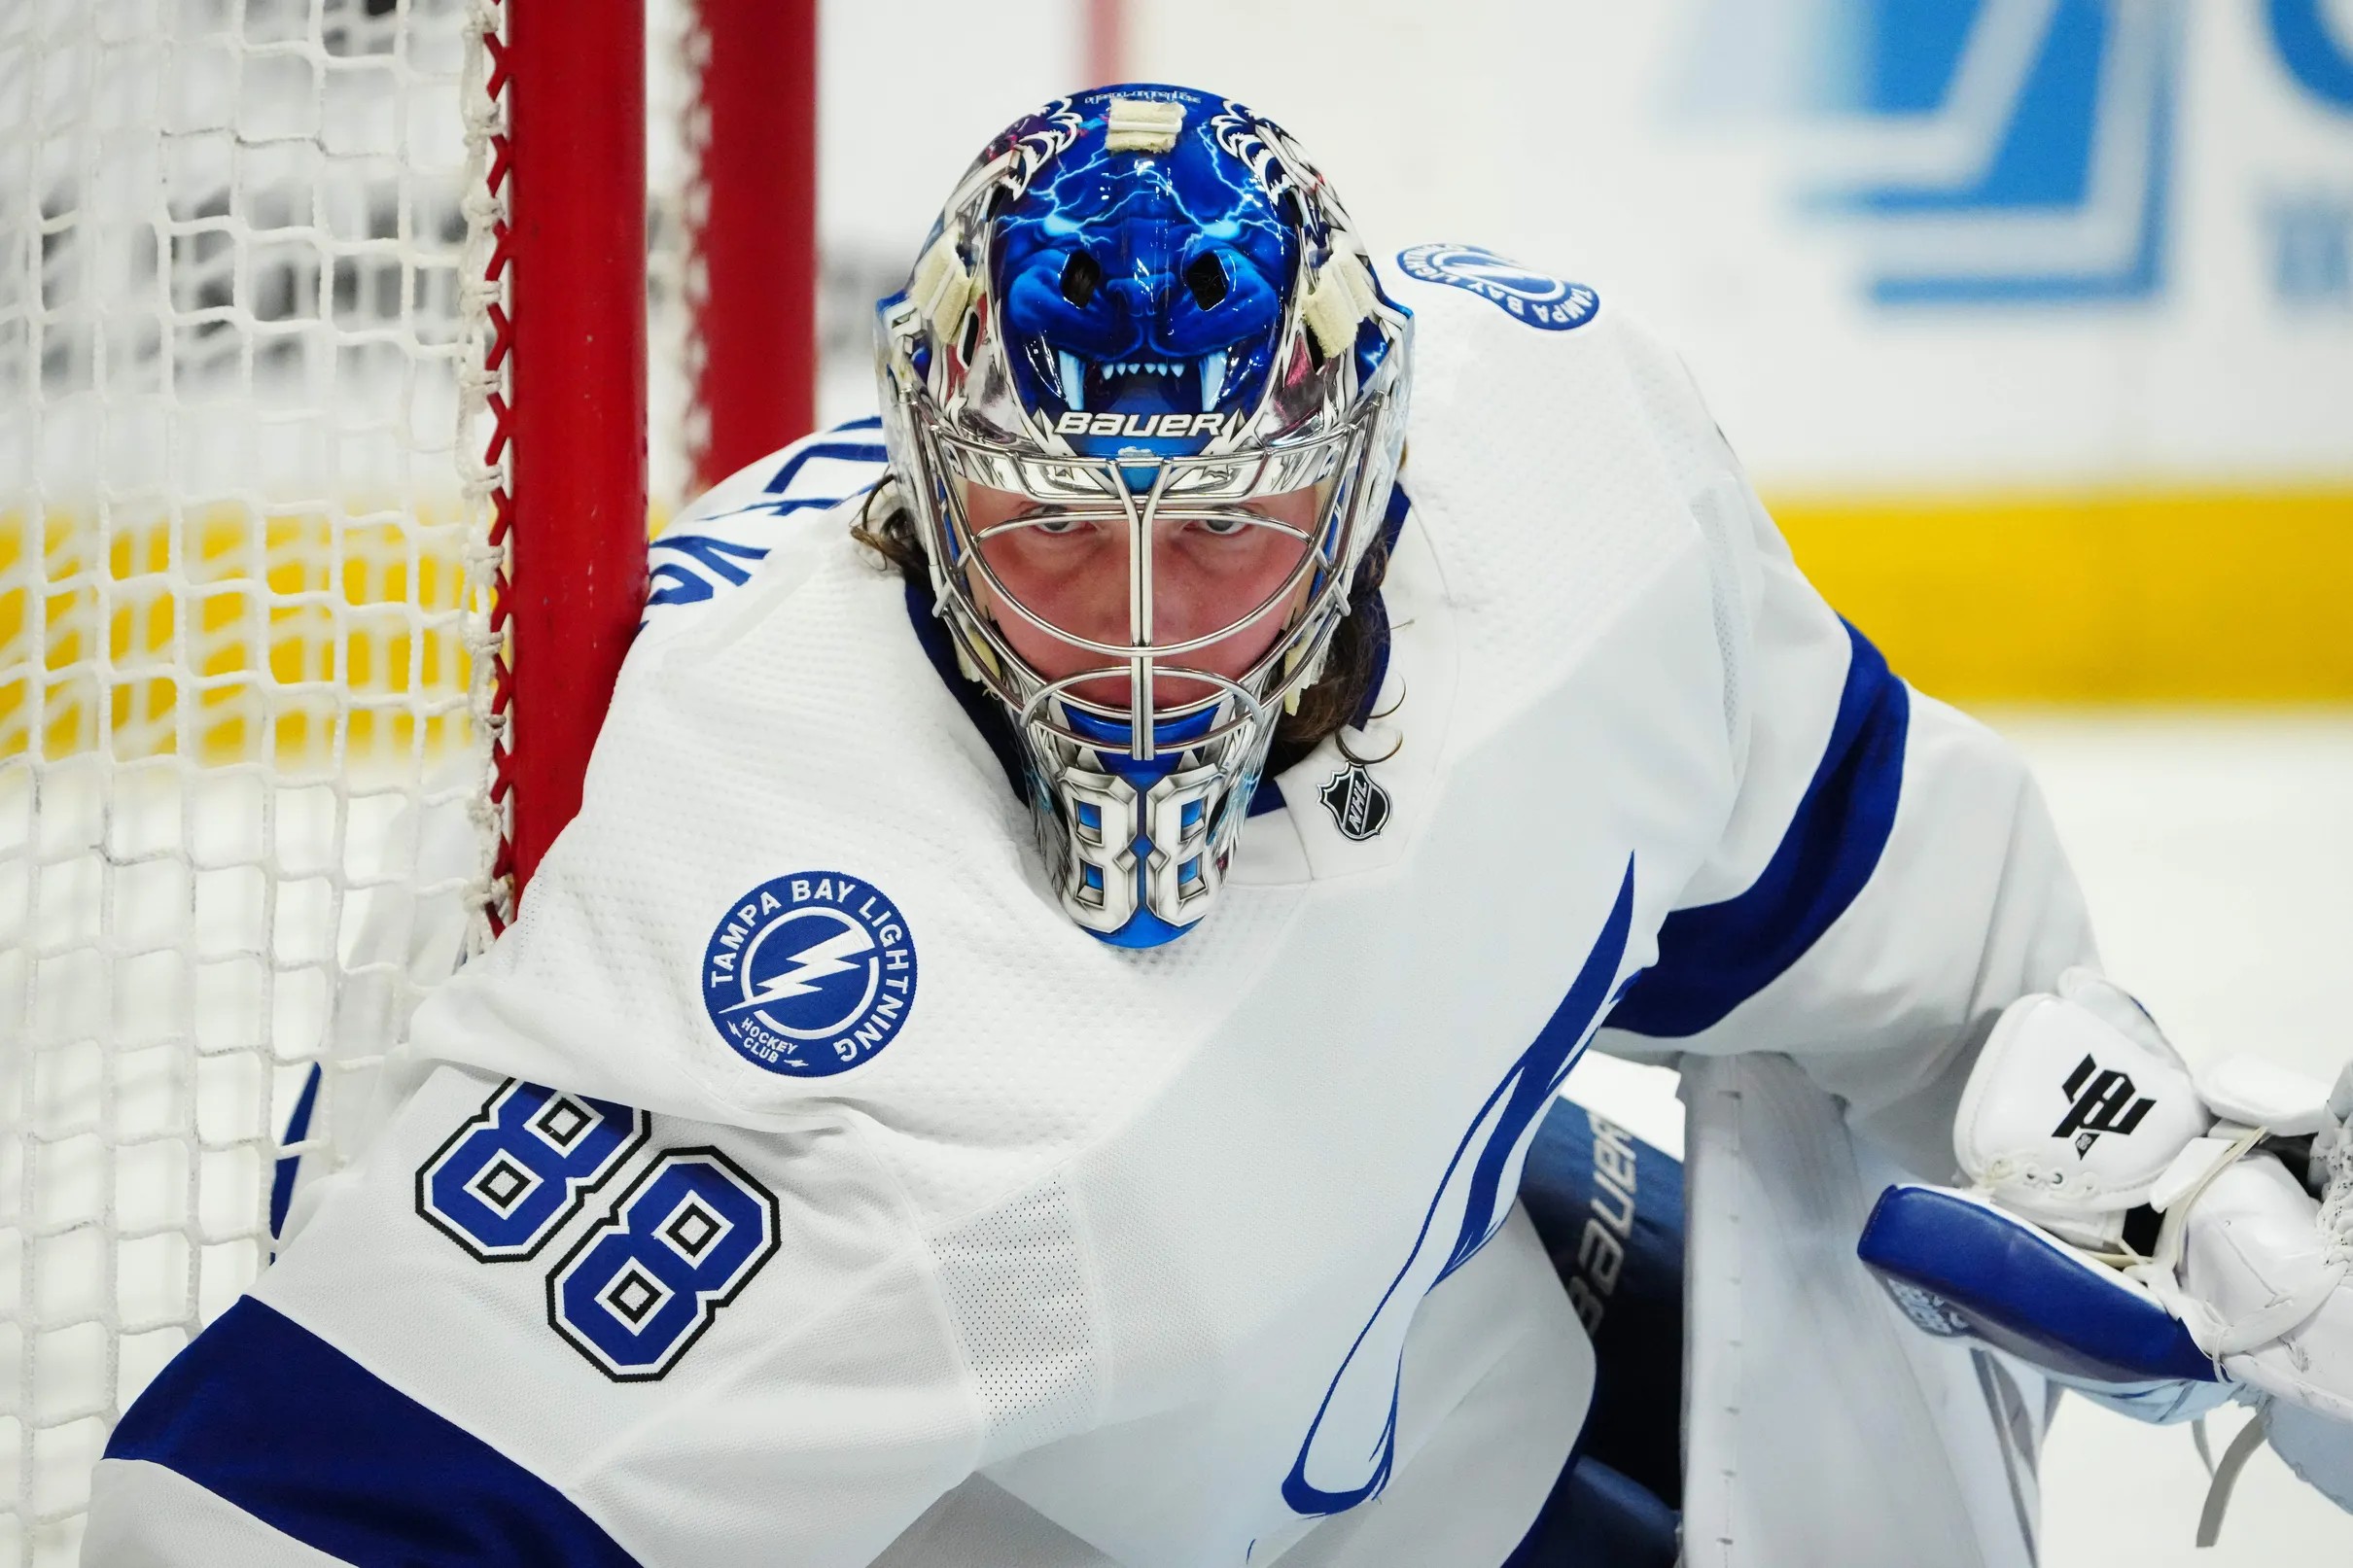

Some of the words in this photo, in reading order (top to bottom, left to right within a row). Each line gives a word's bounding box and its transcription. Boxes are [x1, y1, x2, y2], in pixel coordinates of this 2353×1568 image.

[1467, 282, 1525, 316] BAY
[1531, 288, 1594, 324] TAMPA
[1056, 411, 1224, 436] BAUER
[1349, 780, 1368, 833] NHL
[711, 890, 782, 988] TAMPA
[790, 878, 856, 903] BAY
[833, 896, 909, 1063] LIGHTNING
[742, 1017, 798, 1055] HOCKEY
[743, 1038, 779, 1064] CLUB
[415, 1077, 782, 1382] 88
